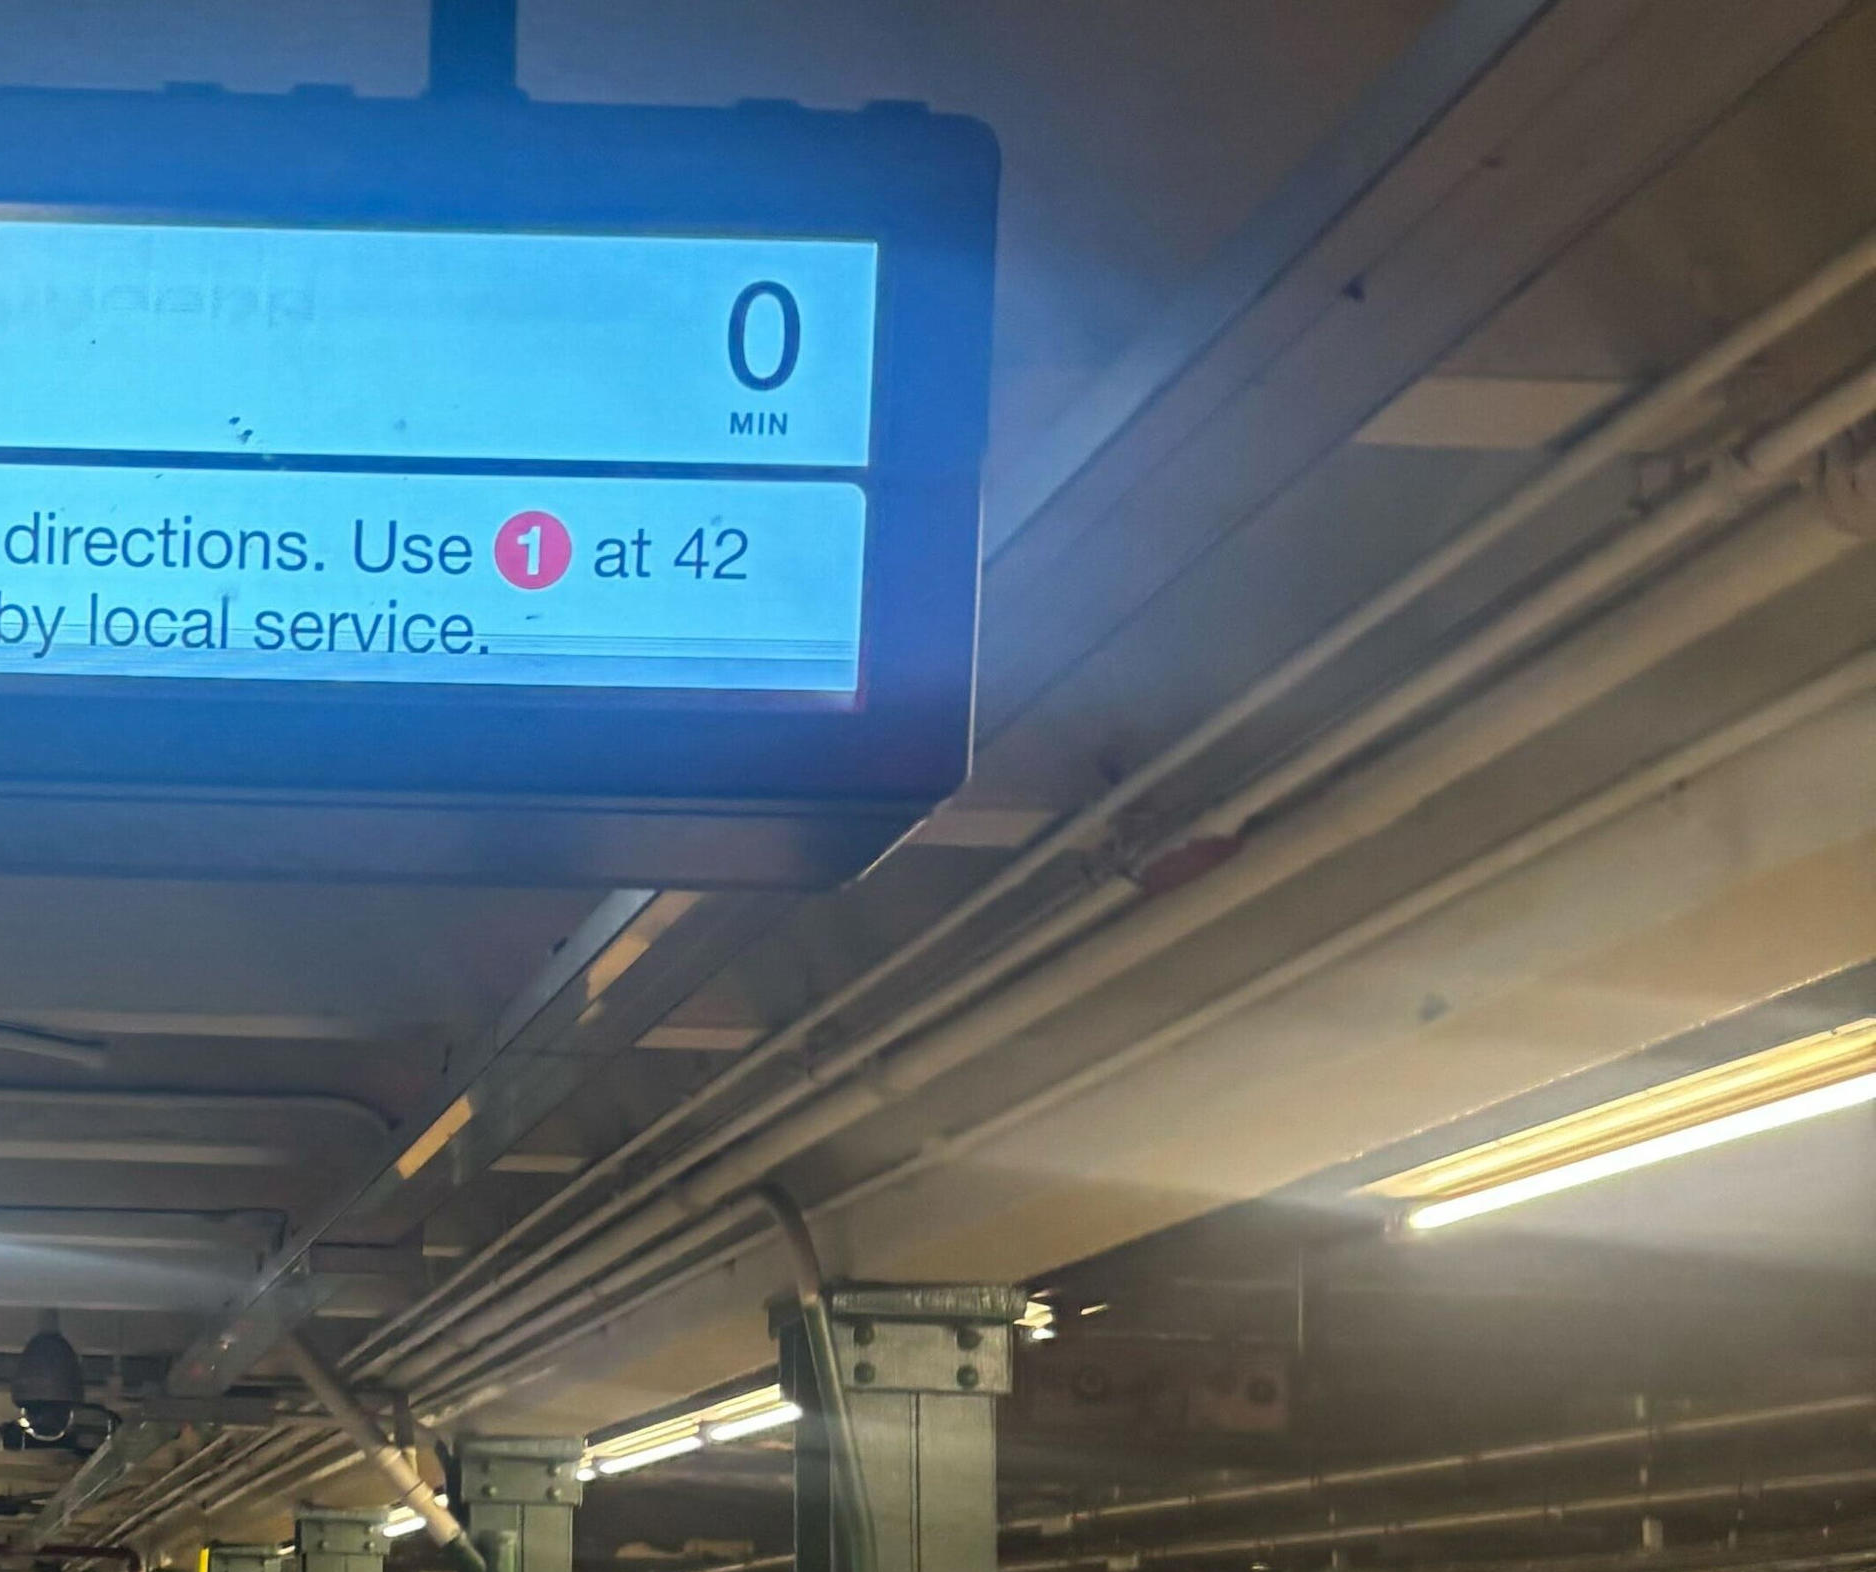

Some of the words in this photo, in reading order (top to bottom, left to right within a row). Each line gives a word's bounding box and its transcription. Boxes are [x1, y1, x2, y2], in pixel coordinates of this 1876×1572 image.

[724, 279, 803, 394] 0
[728, 409, 789, 438] MIN
[2, 512, 327, 573] directions.
[351, 519, 474, 577] Use
[592, 531, 653, 581] at
[672, 526, 750, 582] 42
[86, 592, 232, 653] local
[252, 596, 493, 659] service.
